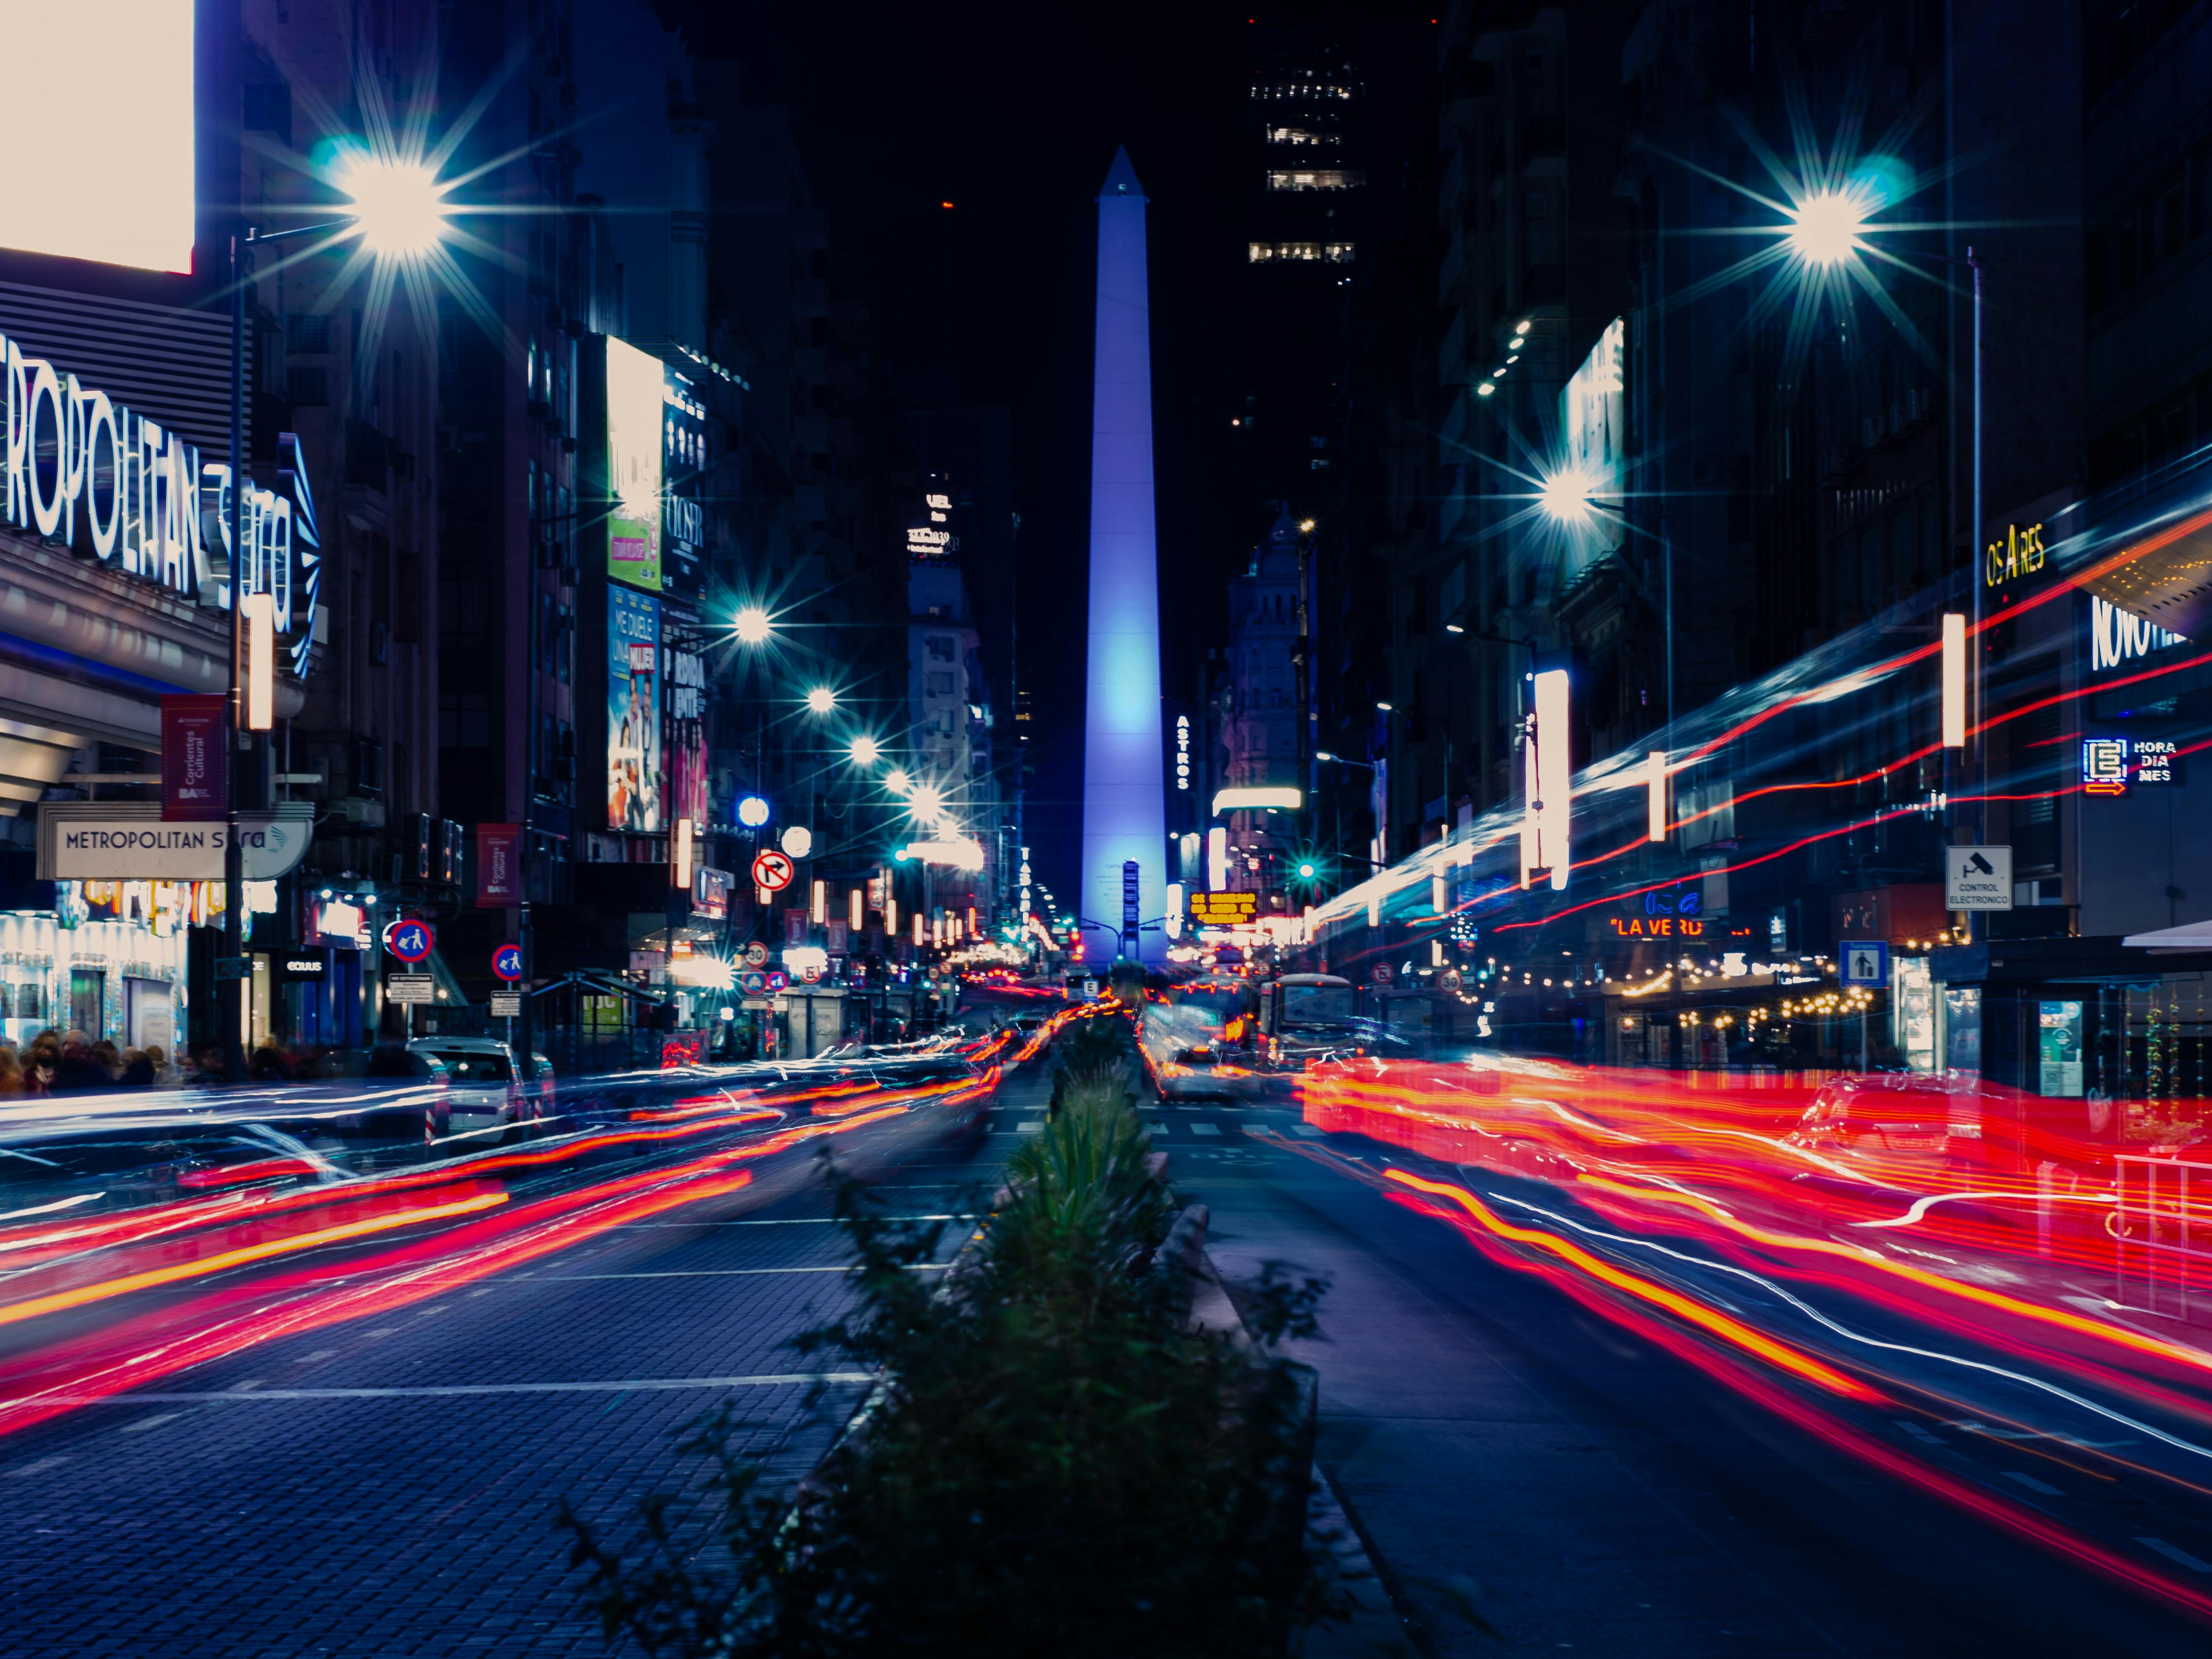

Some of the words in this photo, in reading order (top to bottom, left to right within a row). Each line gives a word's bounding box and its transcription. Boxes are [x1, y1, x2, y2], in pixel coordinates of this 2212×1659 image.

[616, 610, 627, 634] ME
[628, 613, 653, 641] DUELE
[612, 638, 629, 664] UNA
[1177, 716, 1189, 789] ASTROS
[2134, 742, 2176, 753] HORA
[185, 731, 194, 785] Corrientes
[195, 738, 203, 778] Cultural
[2141, 755, 2169, 766] DIA
[2139, 770, 2171, 781] MES
[67, 832, 203, 848] METROPOLITAN
[749, 950, 762, 960] 30
[1088, 982, 1094, 992] E
[1442, 977, 1458, 987] 30
